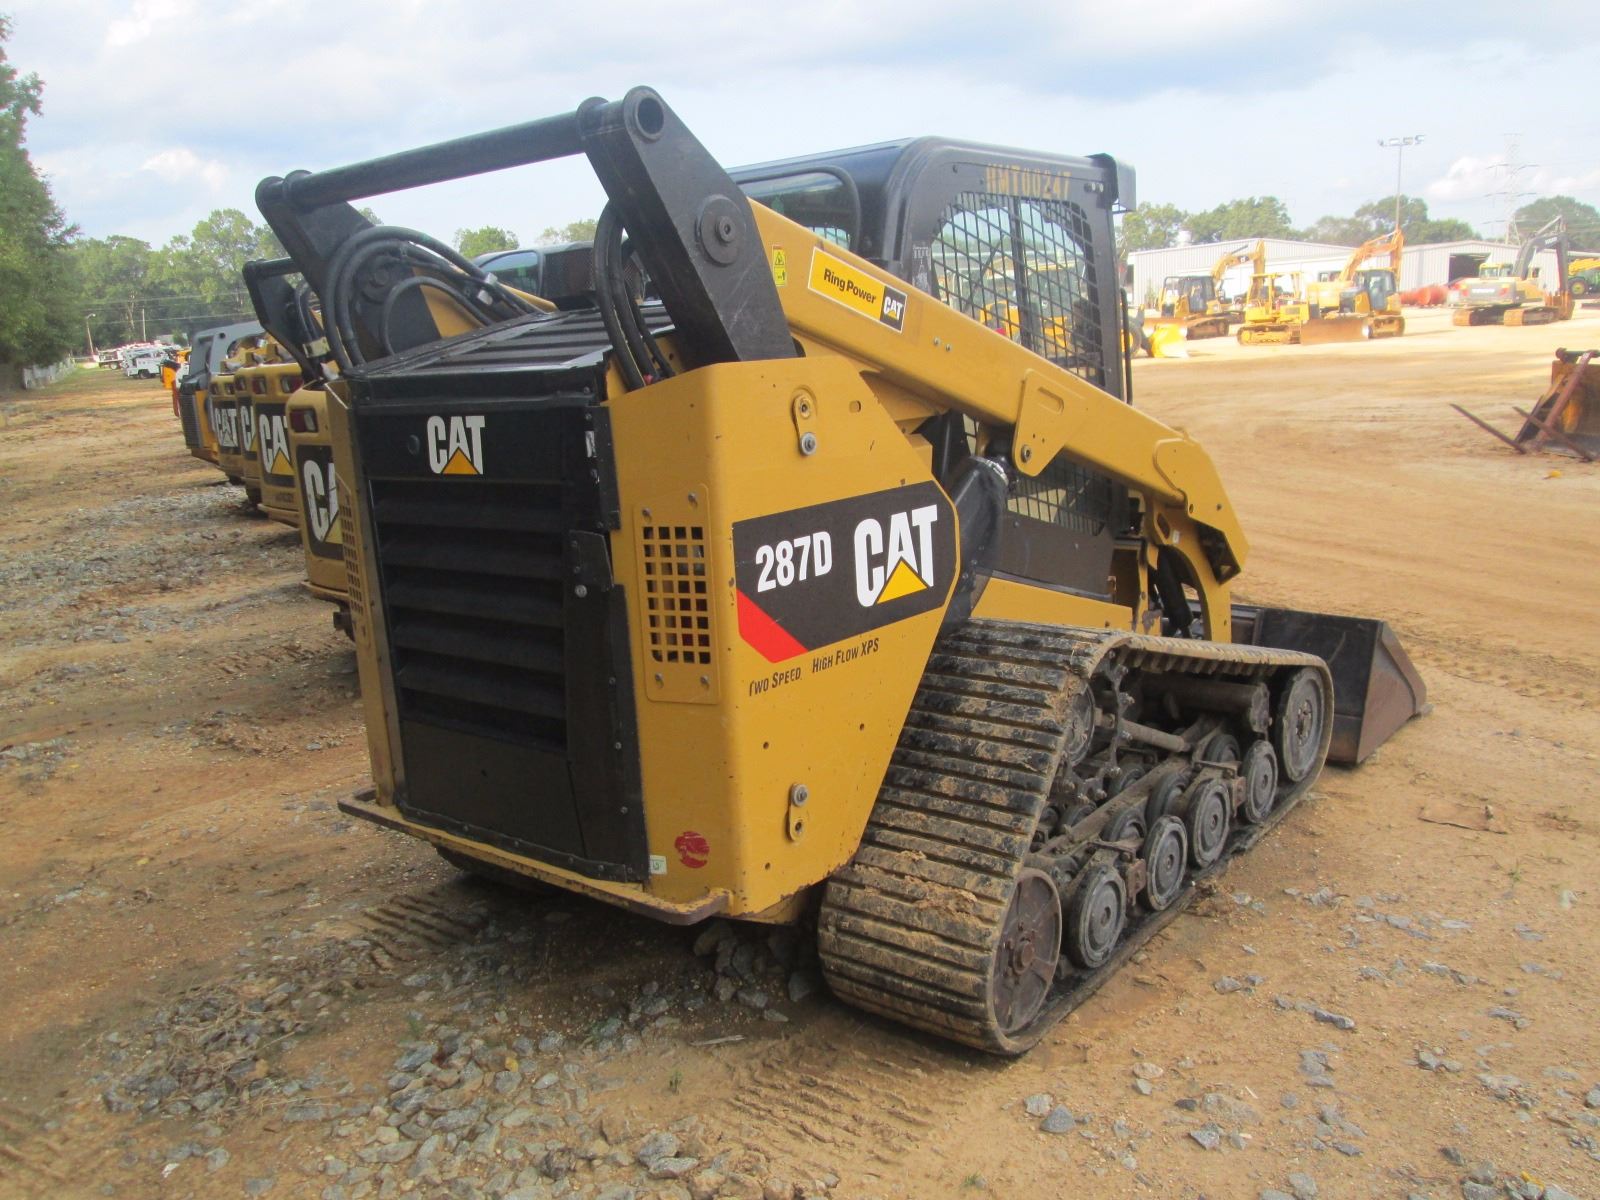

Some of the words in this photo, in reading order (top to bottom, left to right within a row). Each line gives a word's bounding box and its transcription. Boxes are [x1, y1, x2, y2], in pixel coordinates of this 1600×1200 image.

[823, 268, 846, 292] Ring
[846, 280, 877, 304] Power
[883, 296, 903, 320] CAT
[214, 408, 238, 447] CAT
[259, 414, 292, 474] CA
[427, 415, 485, 475] CAT
[755, 531, 832, 592] 287D
[854, 504, 938, 608] CAT
[861, 637, 880, 656] XPS
